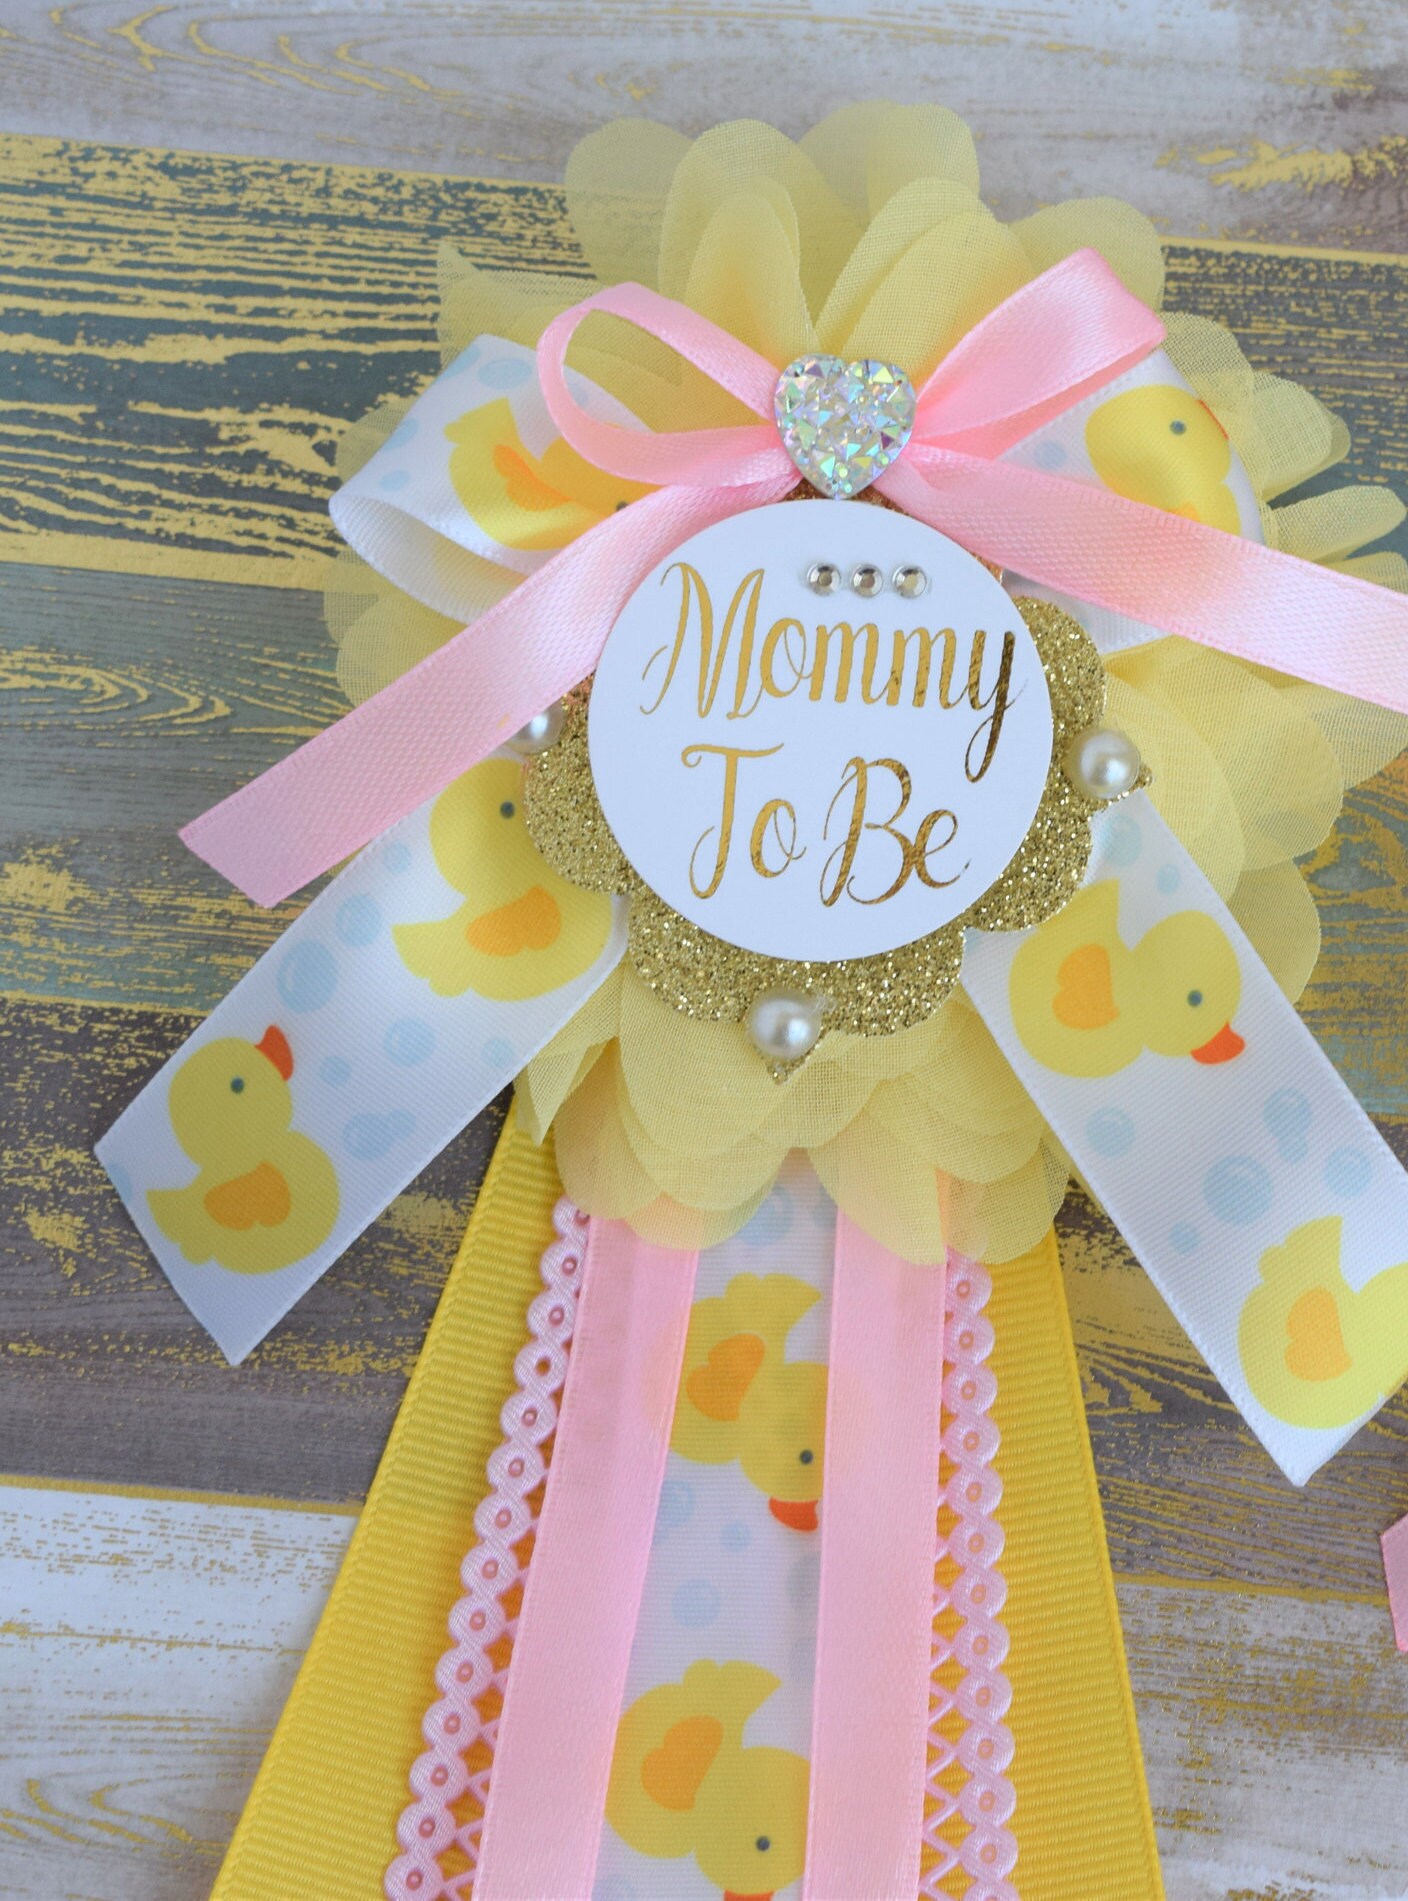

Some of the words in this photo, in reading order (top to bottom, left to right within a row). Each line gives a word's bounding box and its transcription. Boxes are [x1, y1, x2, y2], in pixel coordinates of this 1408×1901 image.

[639, 562, 1028, 783] Mommy
[681, 743, 807, 900] To
[819, 756, 972, 907] Be
